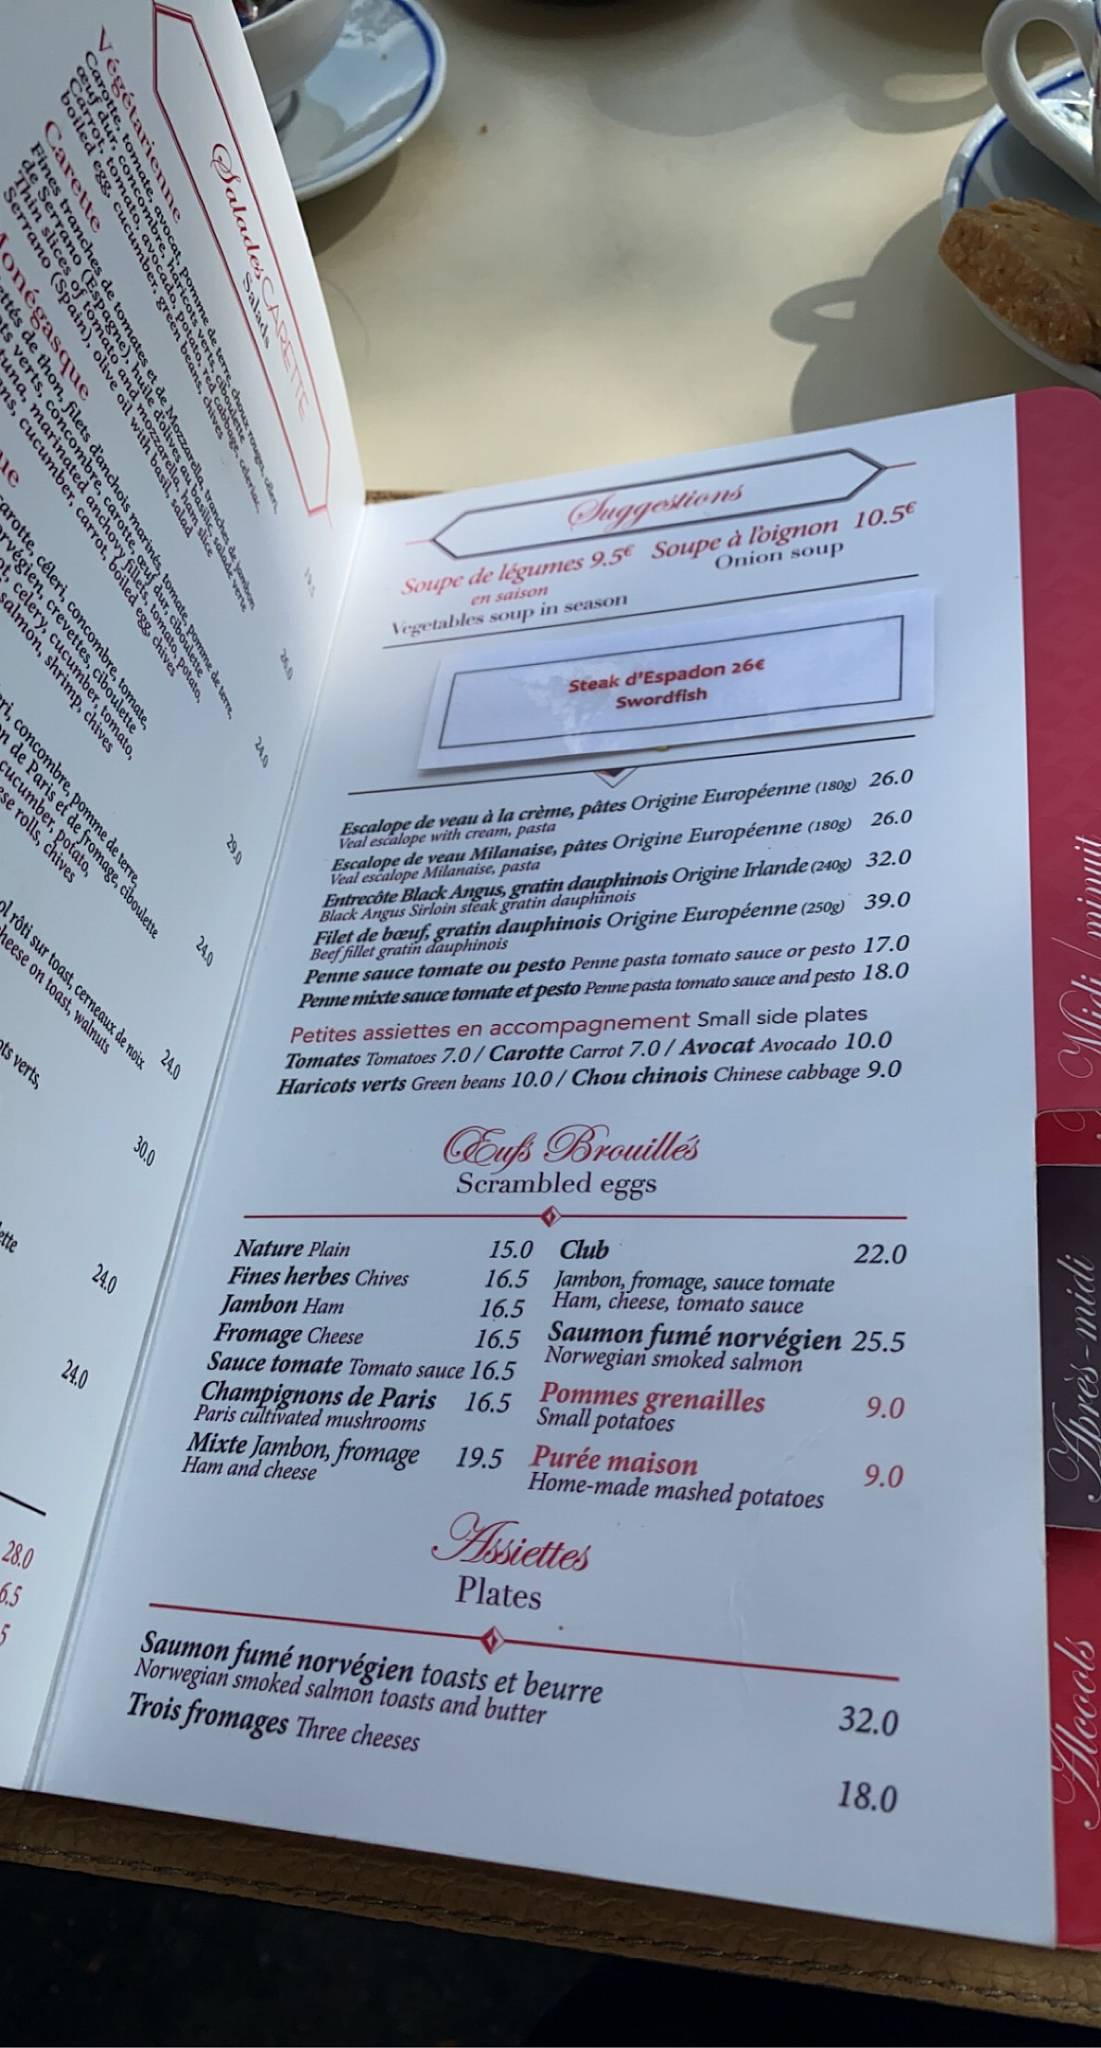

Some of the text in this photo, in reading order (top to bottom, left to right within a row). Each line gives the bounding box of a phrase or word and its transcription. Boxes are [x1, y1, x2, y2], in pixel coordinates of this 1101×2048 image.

[44, 119, 101, 234] Carette
[210, 142, 264, 281] Salades
[60, 88, 224, 441] boiled egg, cucumber, green beans, chives
[242, 271, 270, 350] Salads
[3, 185, 52, 270] Serrano
[50, 271, 92, 349] (Spain),
[92, 349, 118, 392] olive
[130, 416, 151, 456] with
[149, 453, 171, 499] basil,
[170, 498, 194, 539] salad
[566, 484, 745, 531] Suggestions
[650, 536, 723, 560] Soupe
[726, 528, 743, 549] à
[853, 500, 918, 530] 10.5€
[400, 544, 636, 596] Soupe de légumes 9.5€
[714, 542, 845, 570] Onion soup
[470, 585, 549, 607] en saison
[391, 594, 628, 638] Vegetables soup in season
[0, 591, 114, 754] salmon, shrimp, chives
[567, 674, 620, 695] Steak
[730, 657, 766, 675] 26€
[615, 686, 709, 710] Swordfish
[13, 718, 71, 796] concombre,
[68, 792, 108, 841] pomme
[117, 854, 139, 889] terre,
[341, 768, 914, 835] Escalope de veau à la crème, pâtes Origine Européenne (180g) 26.0
[226, 833, 243, 866] 29.0
[325, 848, 913, 907] Entrecôte Black Angus, gratin dauphinois Origine Irlande (240g) 32.0
[314, 890, 912, 946] Filet de bœuf, gratin dauphinois Origine Européenne (250g) 39.0
[318, 889, 637, 923] Black Angus Sirloin steak gratin dauphinois
[195, 934, 214, 968] 24.0
[9, 908, 34, 938] rôti
[49, 952, 75, 985] toast,
[75, 984, 117, 1031] cerneaux
[126, 1048, 145, 1071] noix
[289, 1005, 869, 1044] Petites assiettes en accompagnement Small side plates
[160, 1048, 181, 1081] 24.0
[132, 1134, 156, 1167] 30.0
[456, 1170, 658, 1201] Scrambled eggs
[233, 1238, 351, 1258] Nature Plain
[488, 1239, 535, 1260] 15.0
[559, 1238, 610, 1261] Club
[853, 1243, 908, 1265] 22.0
[91, 1262, 118, 1295] 24.0
[226, 1265, 410, 1287] Fines herbes Chives
[484, 1268, 530, 1289] 16.5
[553, 1269, 836, 1296] Jambon, fromage, sauce tomate
[218, 1293, 345, 1317] Jambon Ham
[479, 1297, 525, 1319] 16.5
[212, 1322, 365, 1350] Fromage Cheese
[474, 1328, 522, 1350] 16.5
[548, 1322, 907, 1356] Saumon fumé norvégien 25.5
[60, 1358, 89, 1390] 24.0
[538, 1381, 766, 1414] Pommes grenailles
[865, 1395, 906, 1420] 9.0
[536, 1406, 676, 1435] Small potatoes
[530, 1446, 698, 1477] Purée maison
[863, 1463, 905, 1489] 9.0
[2, 1540, 34, 1569] 28.0
[430, 1511, 592, 1572] Assiettes
[454, 1575, 542, 1611] Plates
[127, 1691, 421, 1753] Trois fromages Three cheeses
[838, 1705, 899, 1737] 32.0
[1049, 1636, 1101, 1831] Alcools
[837, 1780, 899, 1814] 18.0
